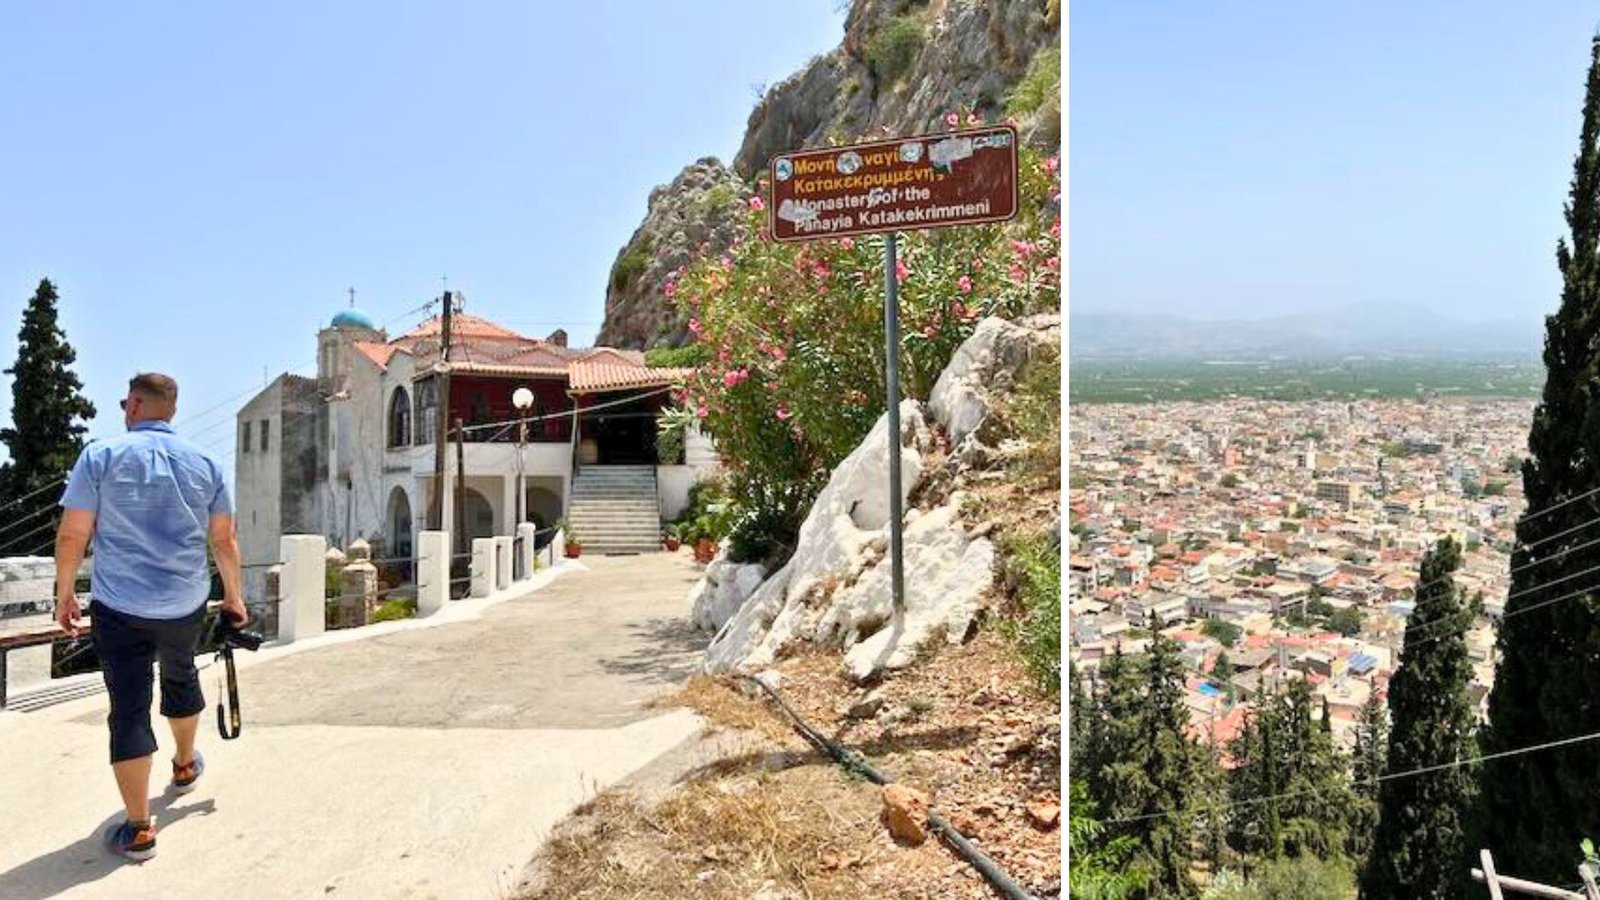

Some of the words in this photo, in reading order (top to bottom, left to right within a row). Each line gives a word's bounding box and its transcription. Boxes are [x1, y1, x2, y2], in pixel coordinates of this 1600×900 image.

[794, 155, 835, 175] Μονή
[883, 189, 897, 204] of
[904, 187, 931, 202] the
[794, 213, 853, 234] Panayia
[859, 199, 990, 226] Katakekrimmeni
